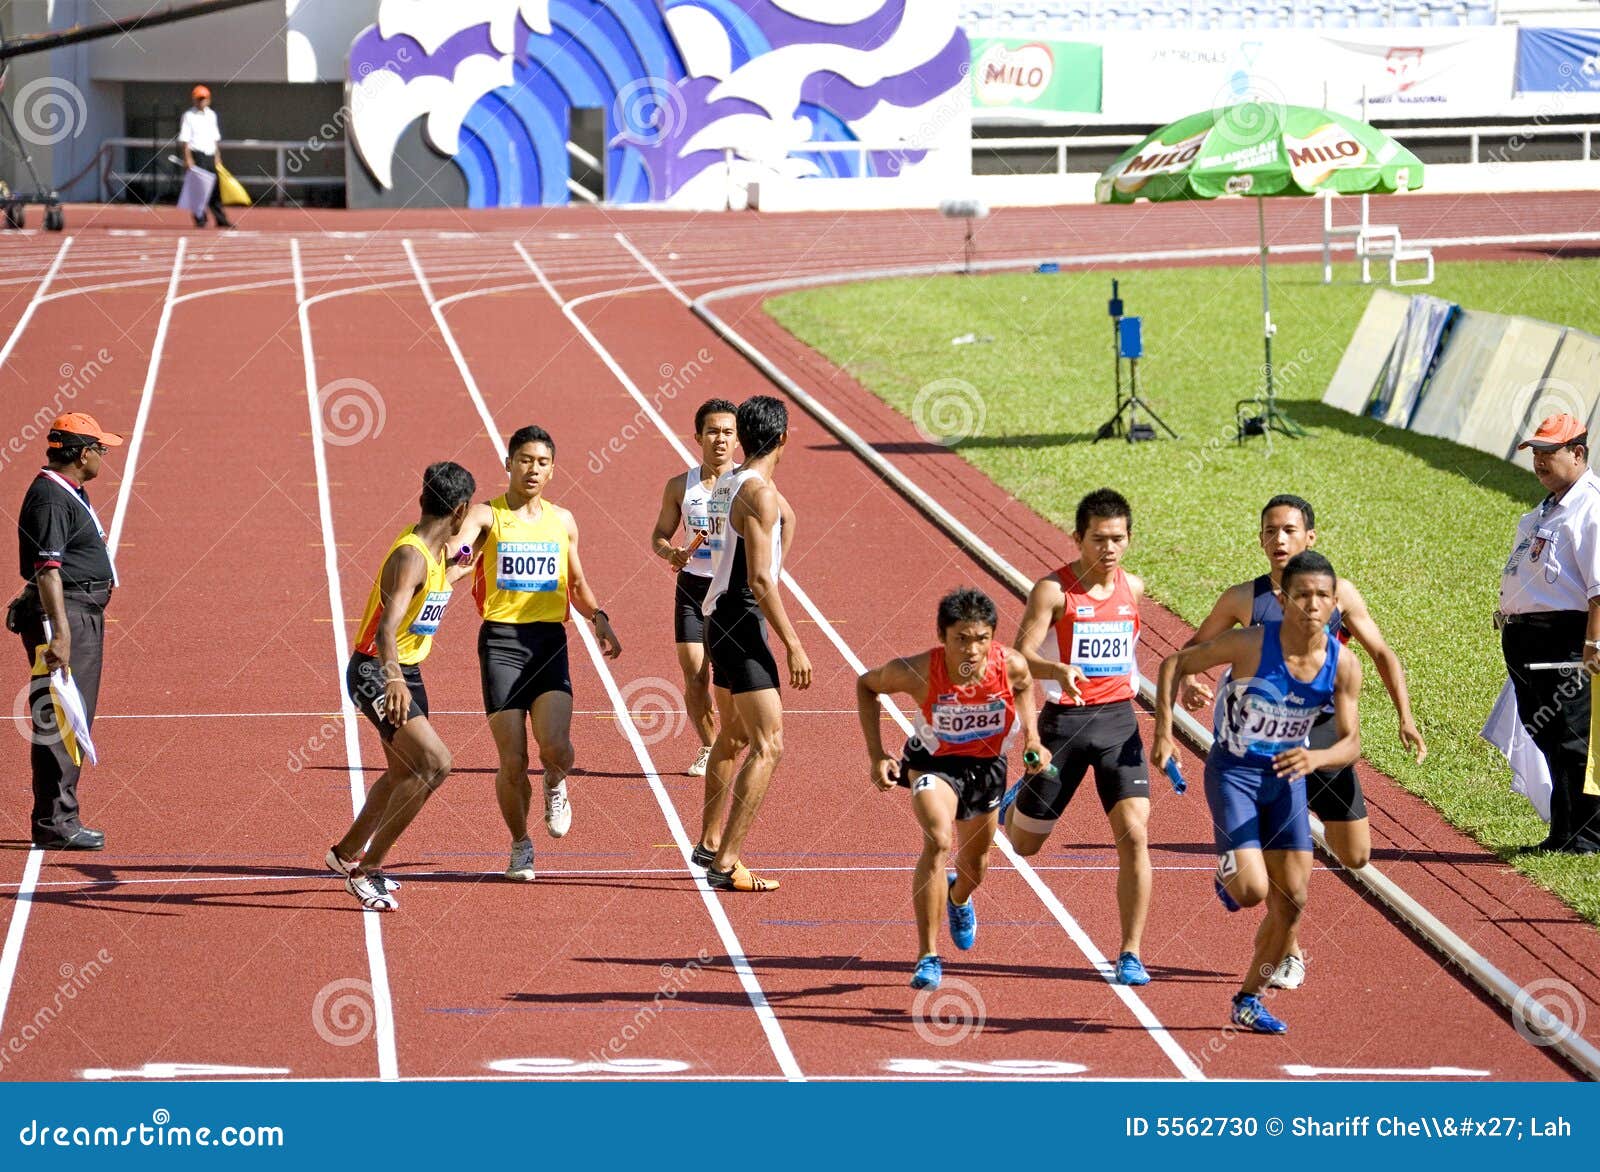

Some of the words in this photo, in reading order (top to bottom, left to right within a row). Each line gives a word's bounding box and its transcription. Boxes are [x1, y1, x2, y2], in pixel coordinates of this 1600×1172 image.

[985, 63, 1043, 88] MILO
[1124, 145, 1200, 175] MILO
[1287, 140, 1360, 168] MILO
[502, 557, 556, 575] B0076
[1078, 638, 1128, 658] E0281
[938, 713, 1001, 732] E0284
[1251, 717, 1310, 738] J0358
